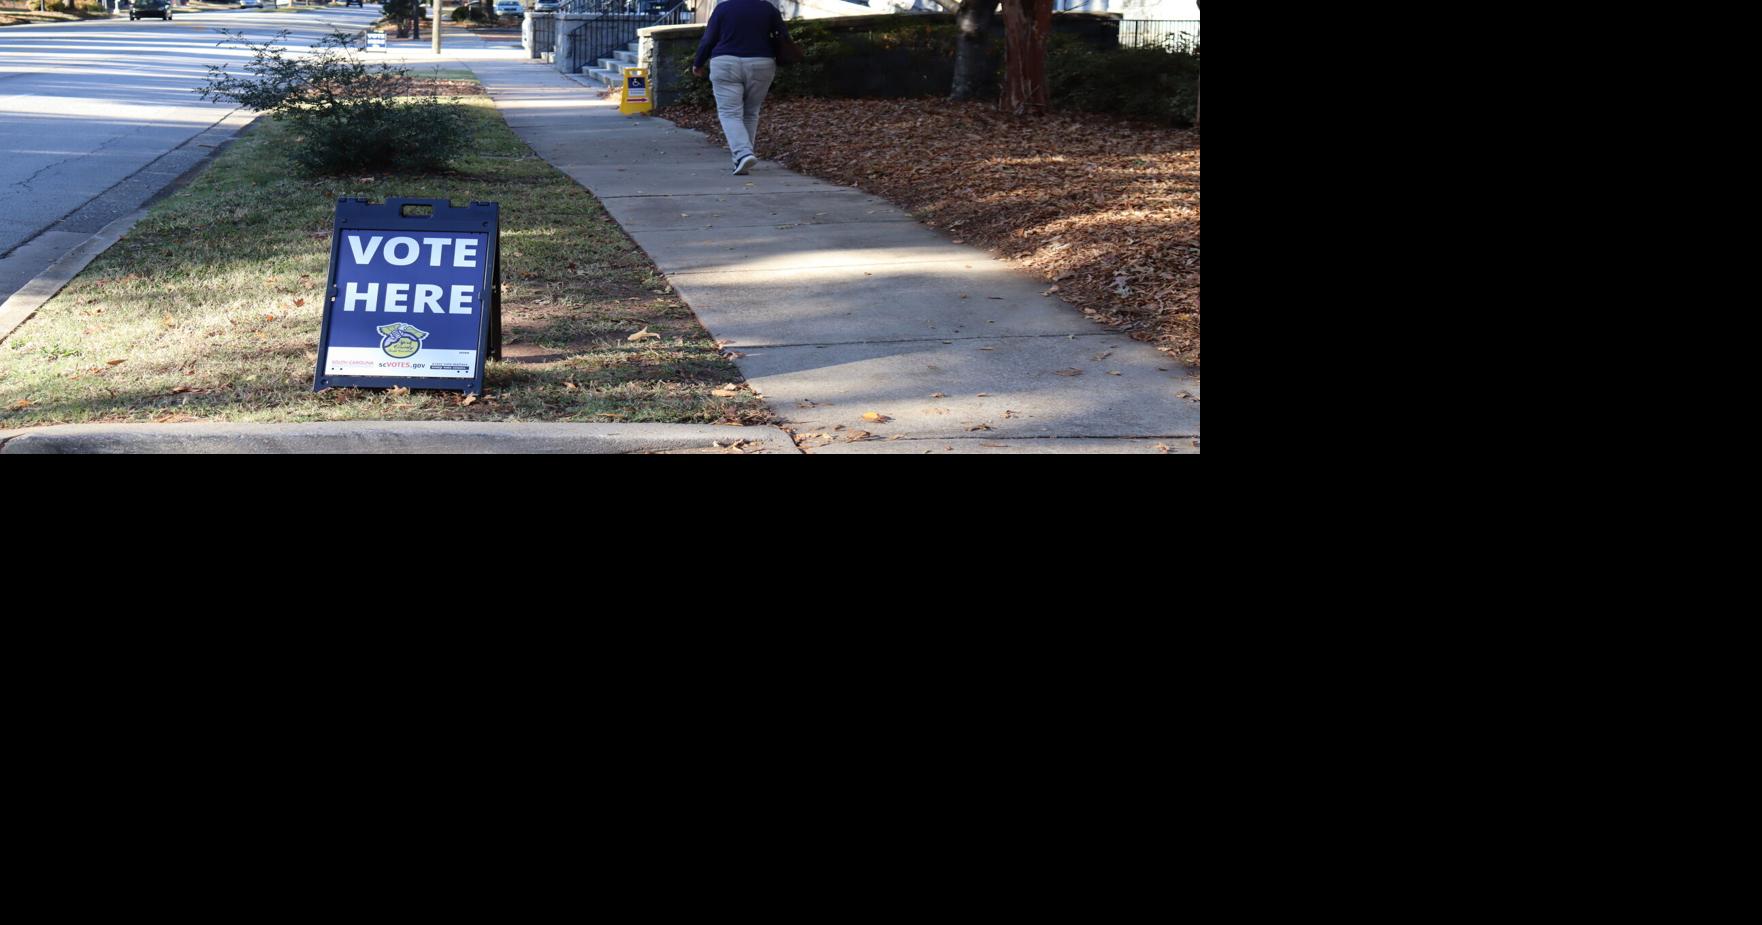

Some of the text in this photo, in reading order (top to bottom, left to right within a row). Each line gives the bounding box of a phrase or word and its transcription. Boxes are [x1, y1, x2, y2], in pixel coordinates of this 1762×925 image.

[347, 235, 479, 268] VOTE
[343, 282, 475, 315] HERE
[378, 361, 426, 369] scVOTES.gov
